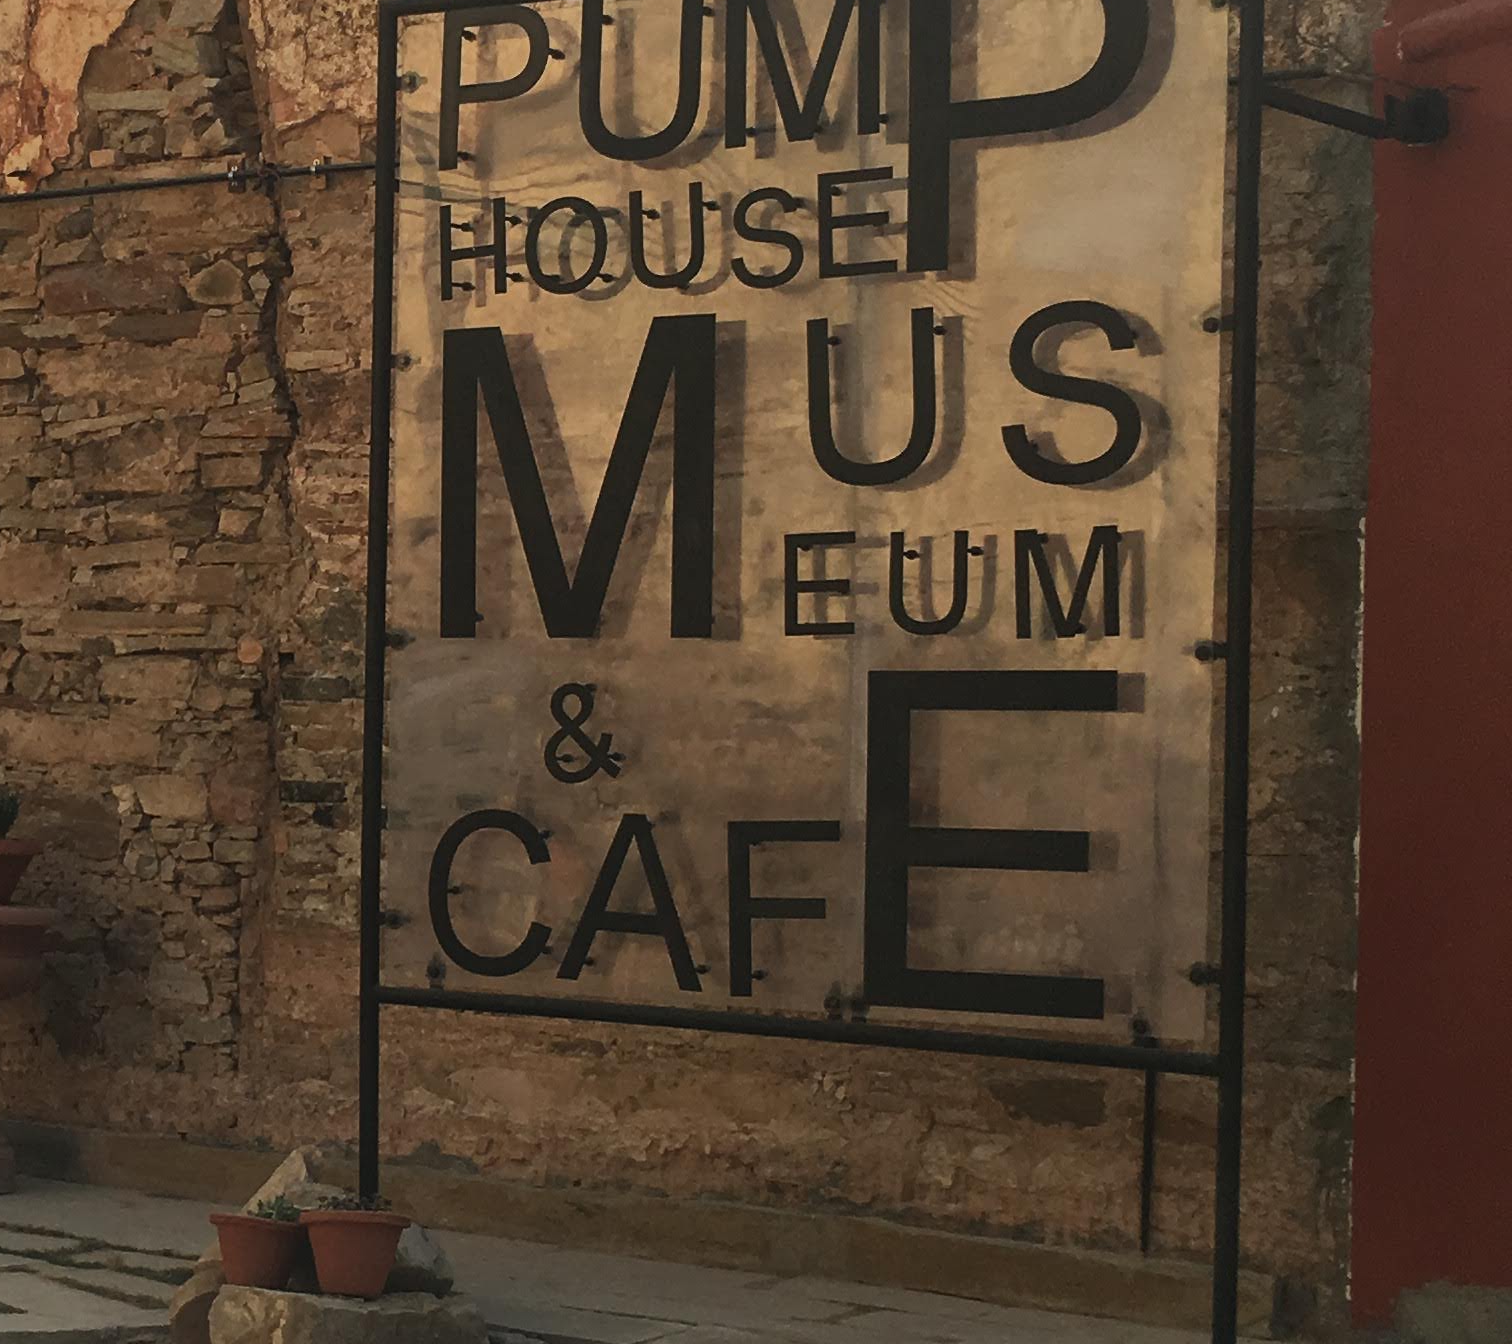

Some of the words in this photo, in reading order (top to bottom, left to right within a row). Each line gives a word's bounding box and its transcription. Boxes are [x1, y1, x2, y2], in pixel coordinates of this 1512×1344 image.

[439, 166, 898, 301] HOUSE
[544, 682, 622, 784] &
[428, 670, 1119, 1020] CAFE
